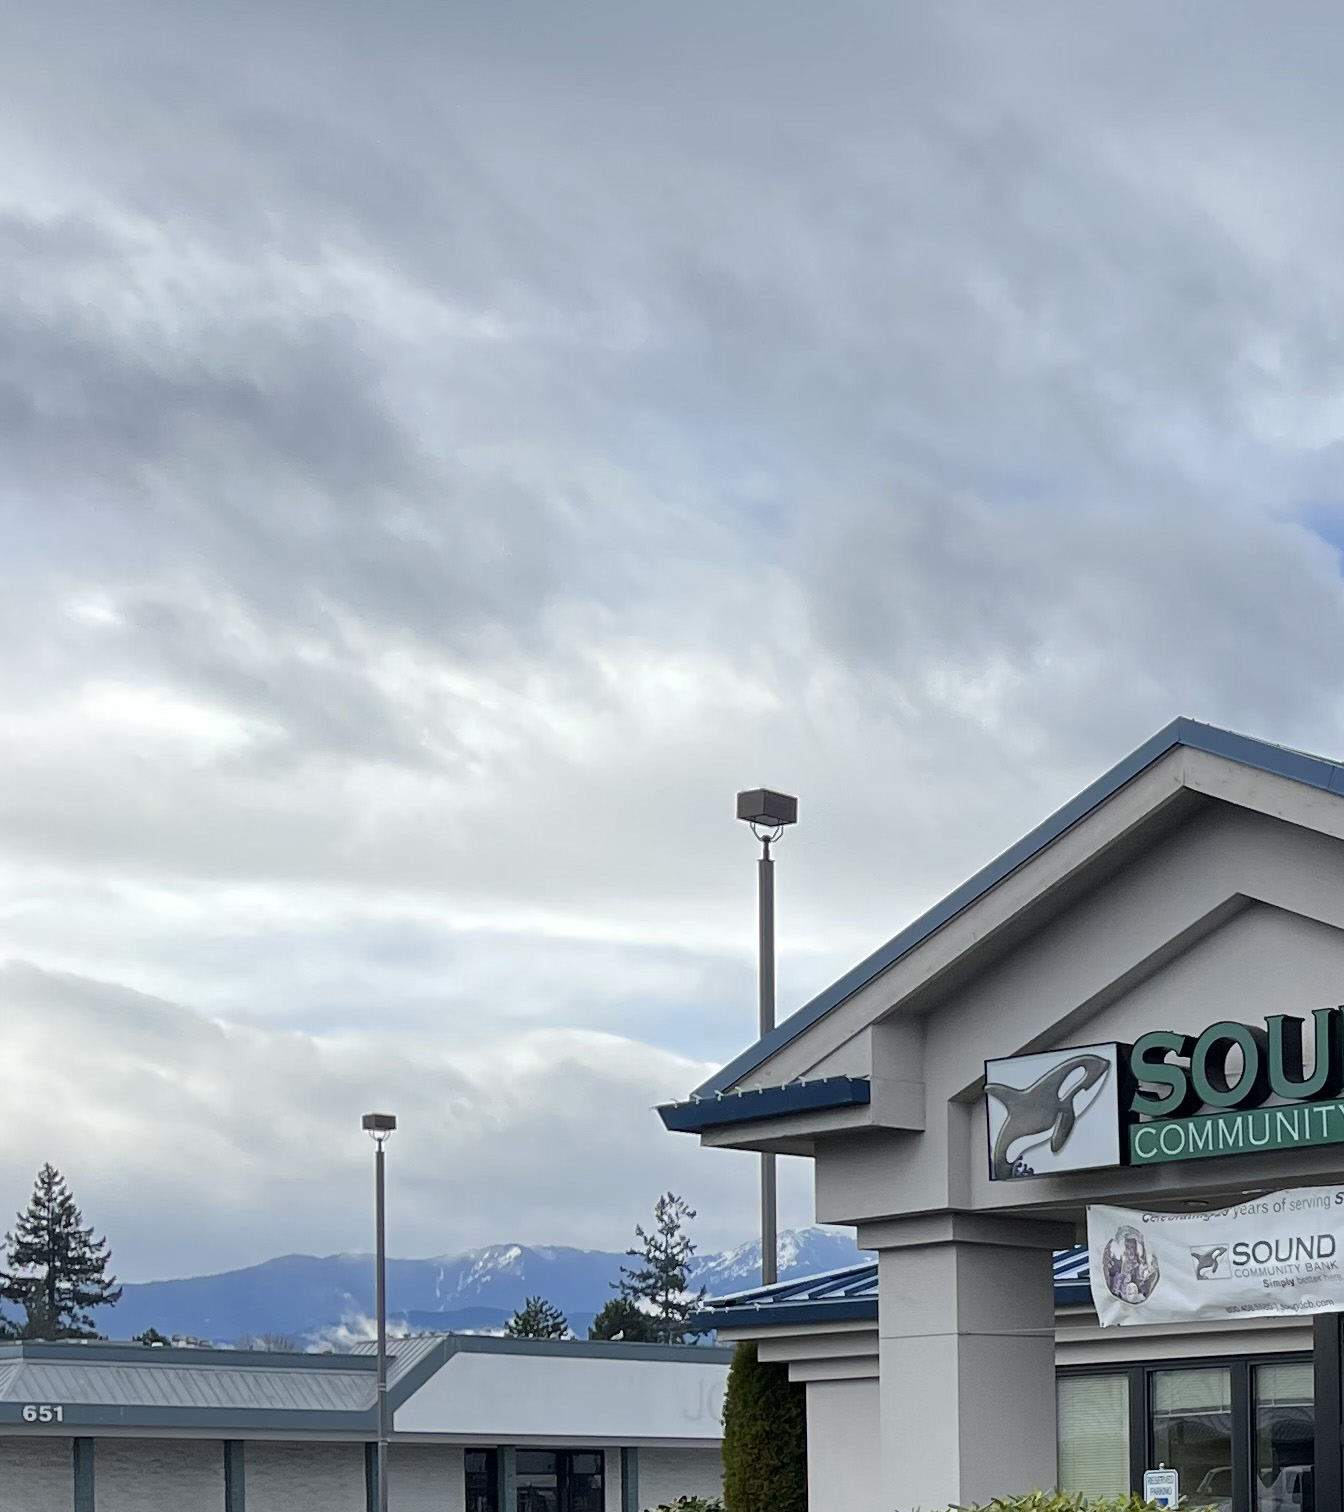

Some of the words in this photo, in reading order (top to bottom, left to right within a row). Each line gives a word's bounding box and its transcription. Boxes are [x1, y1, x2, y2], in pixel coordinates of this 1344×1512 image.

[1233, 1202, 1269, 1219] years
[1273, 1198, 1286, 1213] of
[1289, 1193, 1331, 1212] serving
[1232, 1233, 1336, 1266] SOUND
[1234, 1264, 1300, 1279] COMMUNITY
[1304, 1260, 1340, 1273] BANK
[1262, 1277, 1295, 1289] Simply
[22, 1405, 63, 1422] 651
